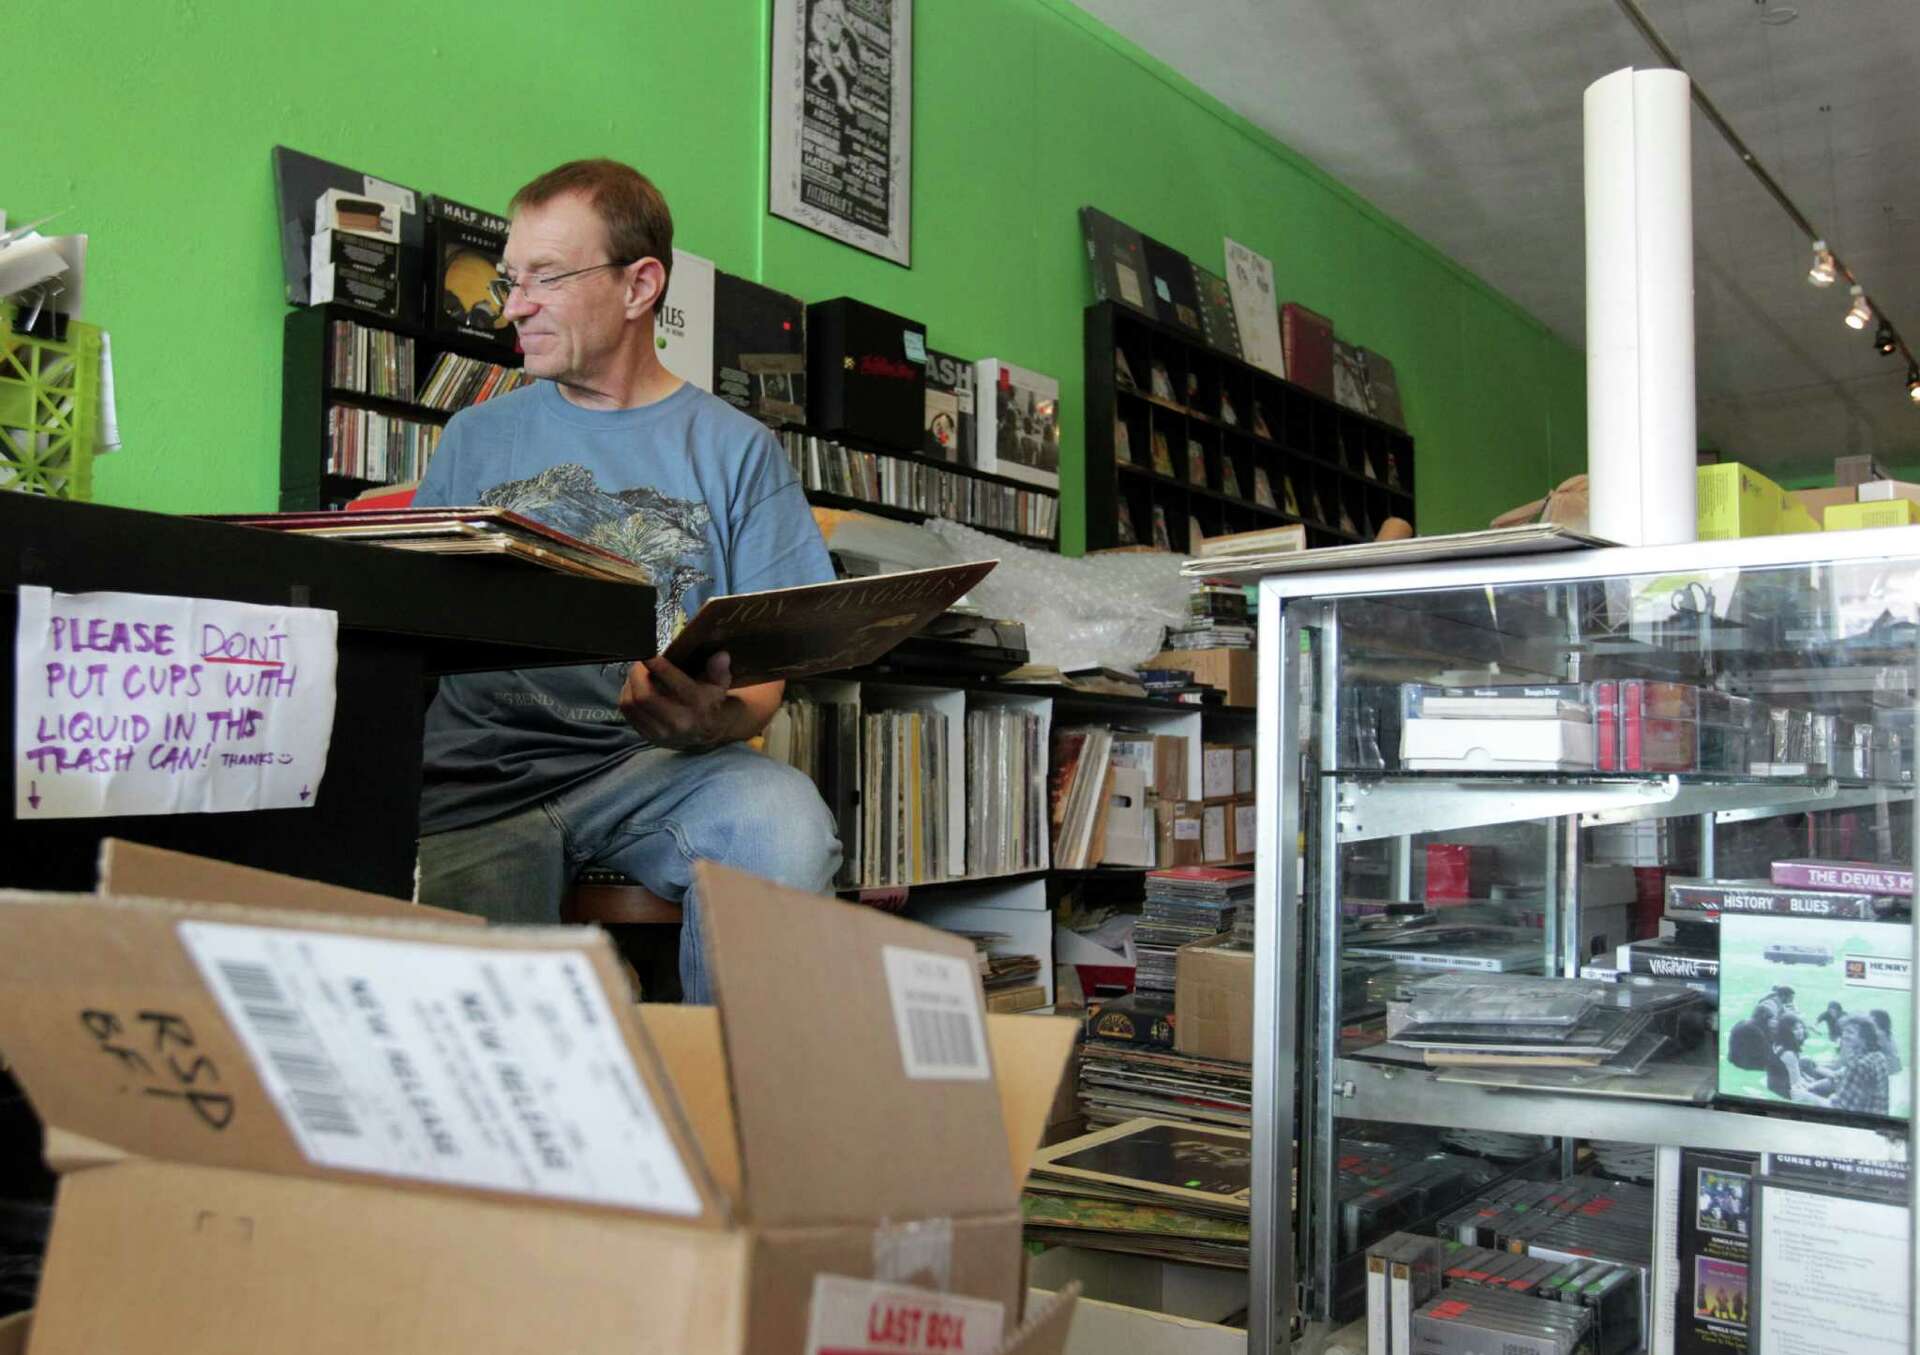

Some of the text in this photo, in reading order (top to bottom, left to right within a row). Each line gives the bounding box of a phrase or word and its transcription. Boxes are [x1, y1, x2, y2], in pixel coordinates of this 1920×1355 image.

[443, 203, 477, 222] HALF
[51, 616, 176, 656] PLEASE
[46, 662, 298, 700] PUT CUPS WITH
[36, 711, 150, 743] LIQUID
[164, 711, 197, 742] IN
[25, 742, 275, 775] TRASH CAN! THANKS
[1808, 868, 1838, 884] THE
[1840, 871, 1896, 890] DEVIL'S
[1722, 894, 1775, 912] HISTORY
[1789, 897, 1831, 915] BLUES
[1868, 961, 1909, 973] HENRY
[1776, 1154, 1812, 1167] CURSE
[1814, 1160, 1829, 1168] OF
[1831, 1162, 1854, 1173] THE
[1855, 1166, 1907, 1180] CRIMSON
[867, 1302, 923, 1344] LAST
